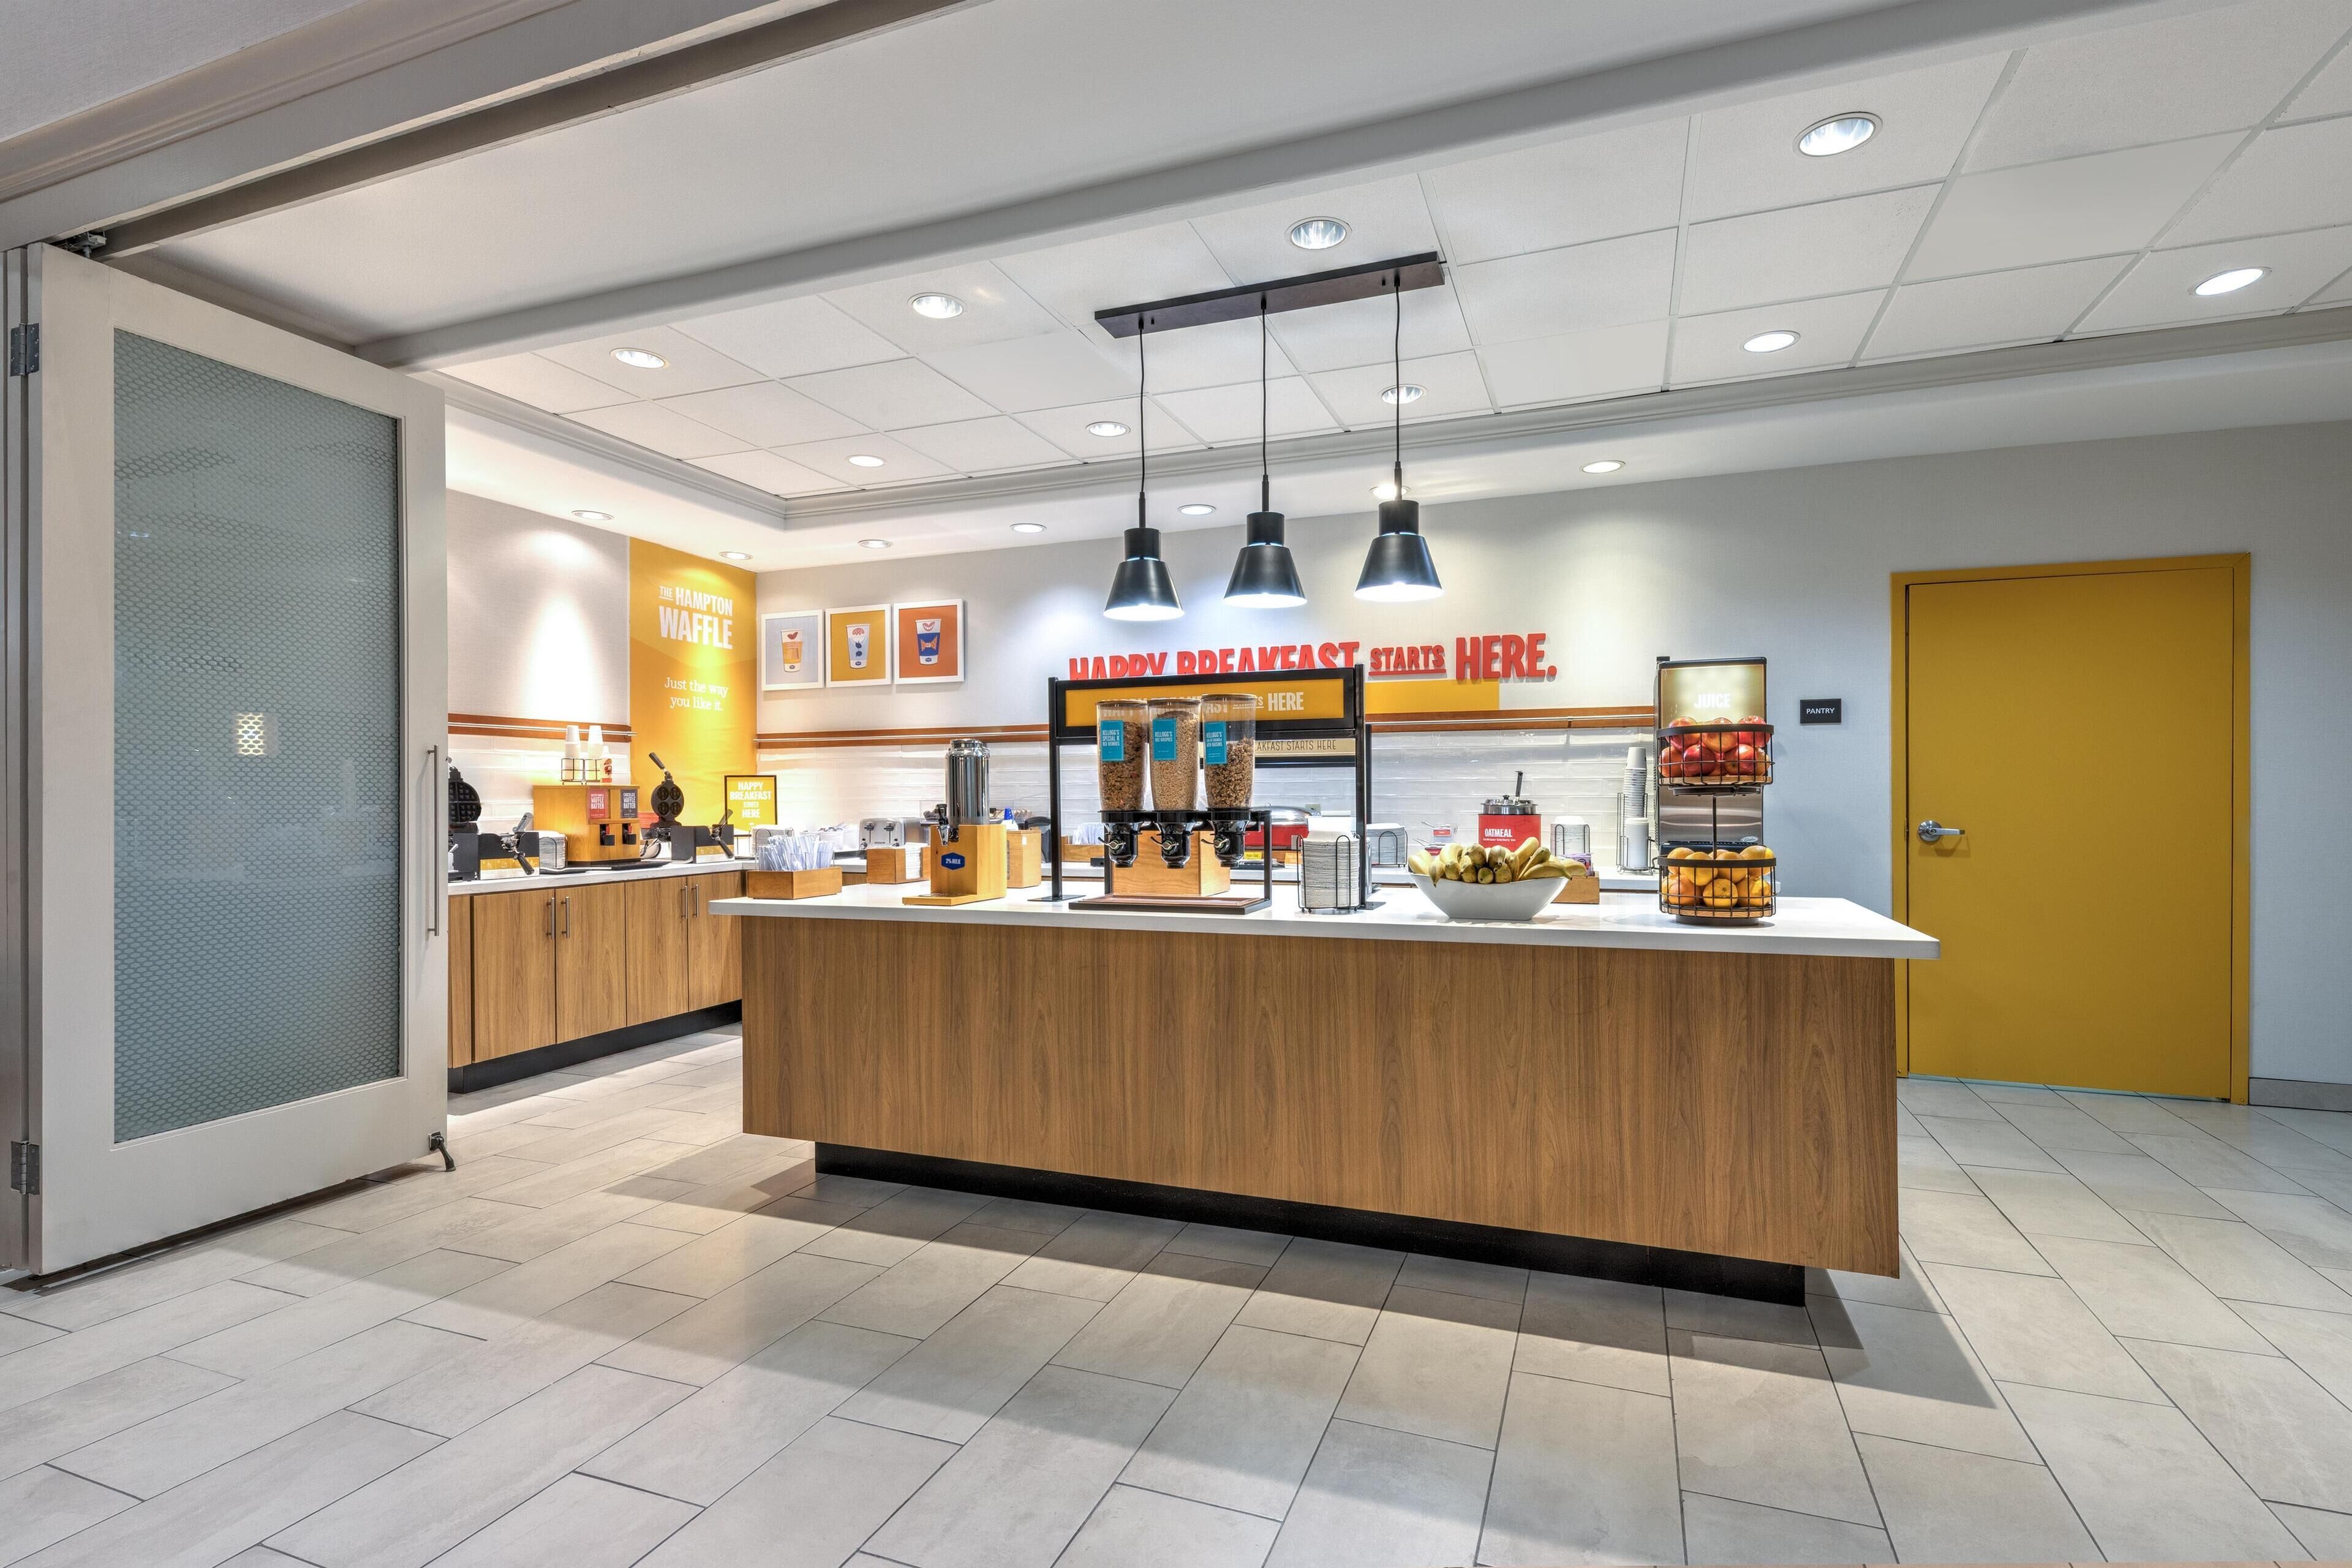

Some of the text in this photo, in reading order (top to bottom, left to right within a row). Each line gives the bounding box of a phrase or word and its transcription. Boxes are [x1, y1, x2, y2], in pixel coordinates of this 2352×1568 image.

[659, 586, 733, 617] THE HAMPTON
[659, 605, 733, 649] WAFFLE
[1370, 644, 1444, 670] STARTS
[1455, 633, 1558, 679] HERE.
[665, 677, 728, 698] Just the way
[670, 696, 723, 711] you like it.
[1268, 692, 1304, 711] HERE
[1693, 693, 1730, 708] JUICE
[1256, 739, 1336, 752] AKFAST STARTS HERE
[737, 782, 764, 790] HAPPY
[729, 791, 772, 801] BREAKFAST
[742, 809, 761, 818] HERE
[1485, 828, 1513, 837] OATMEAL
